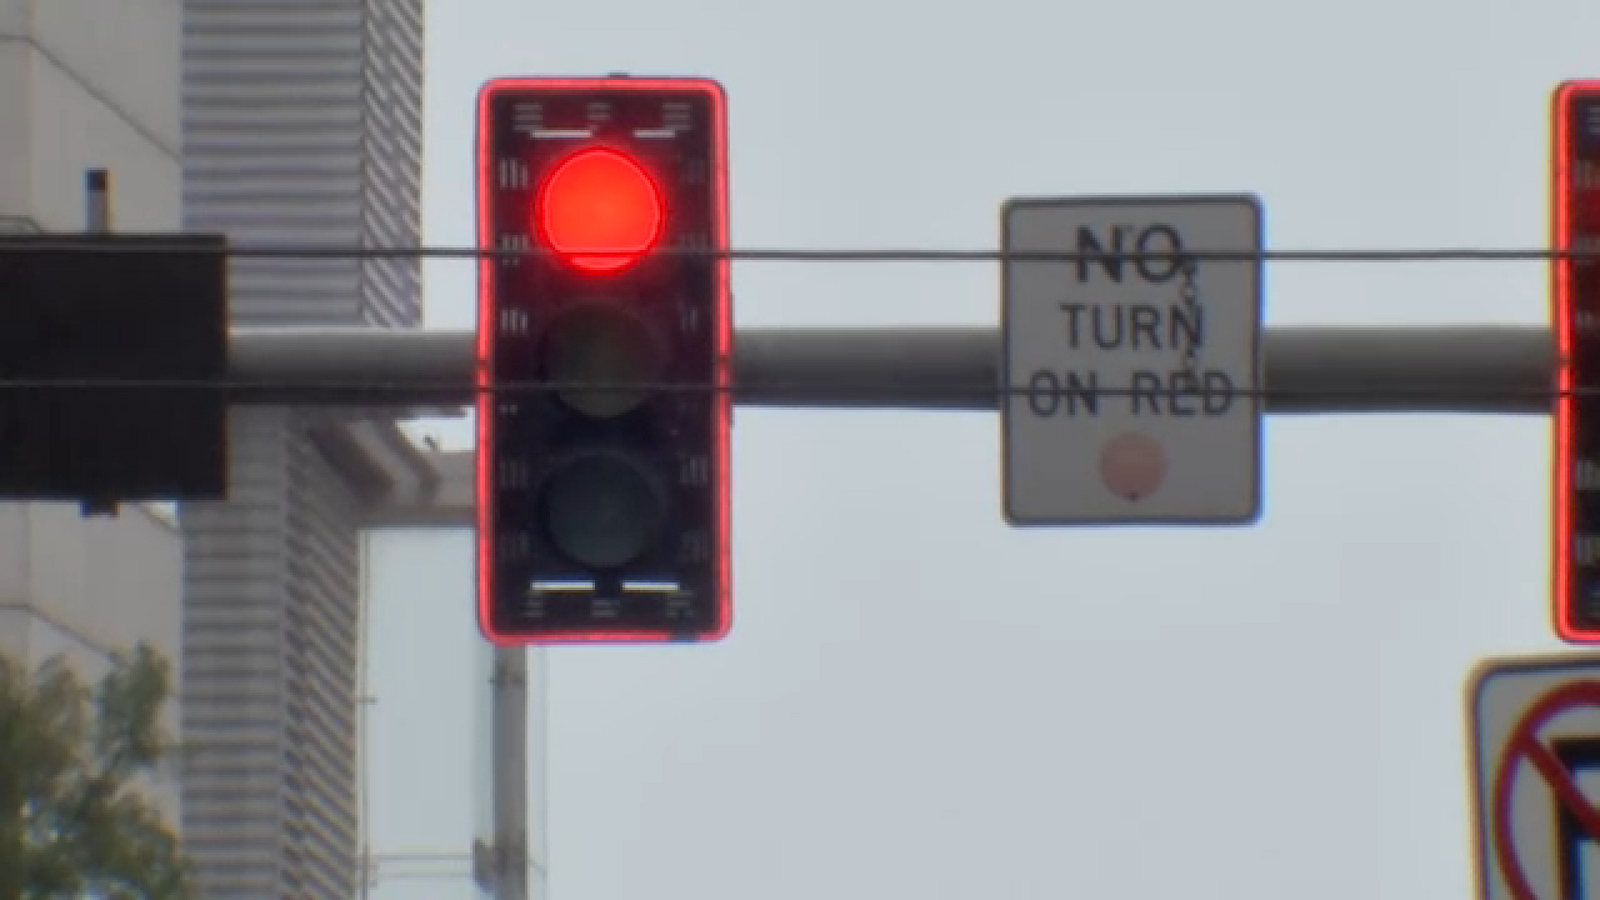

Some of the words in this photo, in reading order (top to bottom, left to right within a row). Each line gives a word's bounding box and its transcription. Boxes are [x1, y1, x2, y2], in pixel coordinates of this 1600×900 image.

[1075, 223, 1183, 283] NO
[1060, 303, 1203, 349] TURN
[1028, 369, 1098, 418] ON
[1131, 369, 1233, 417] RED
